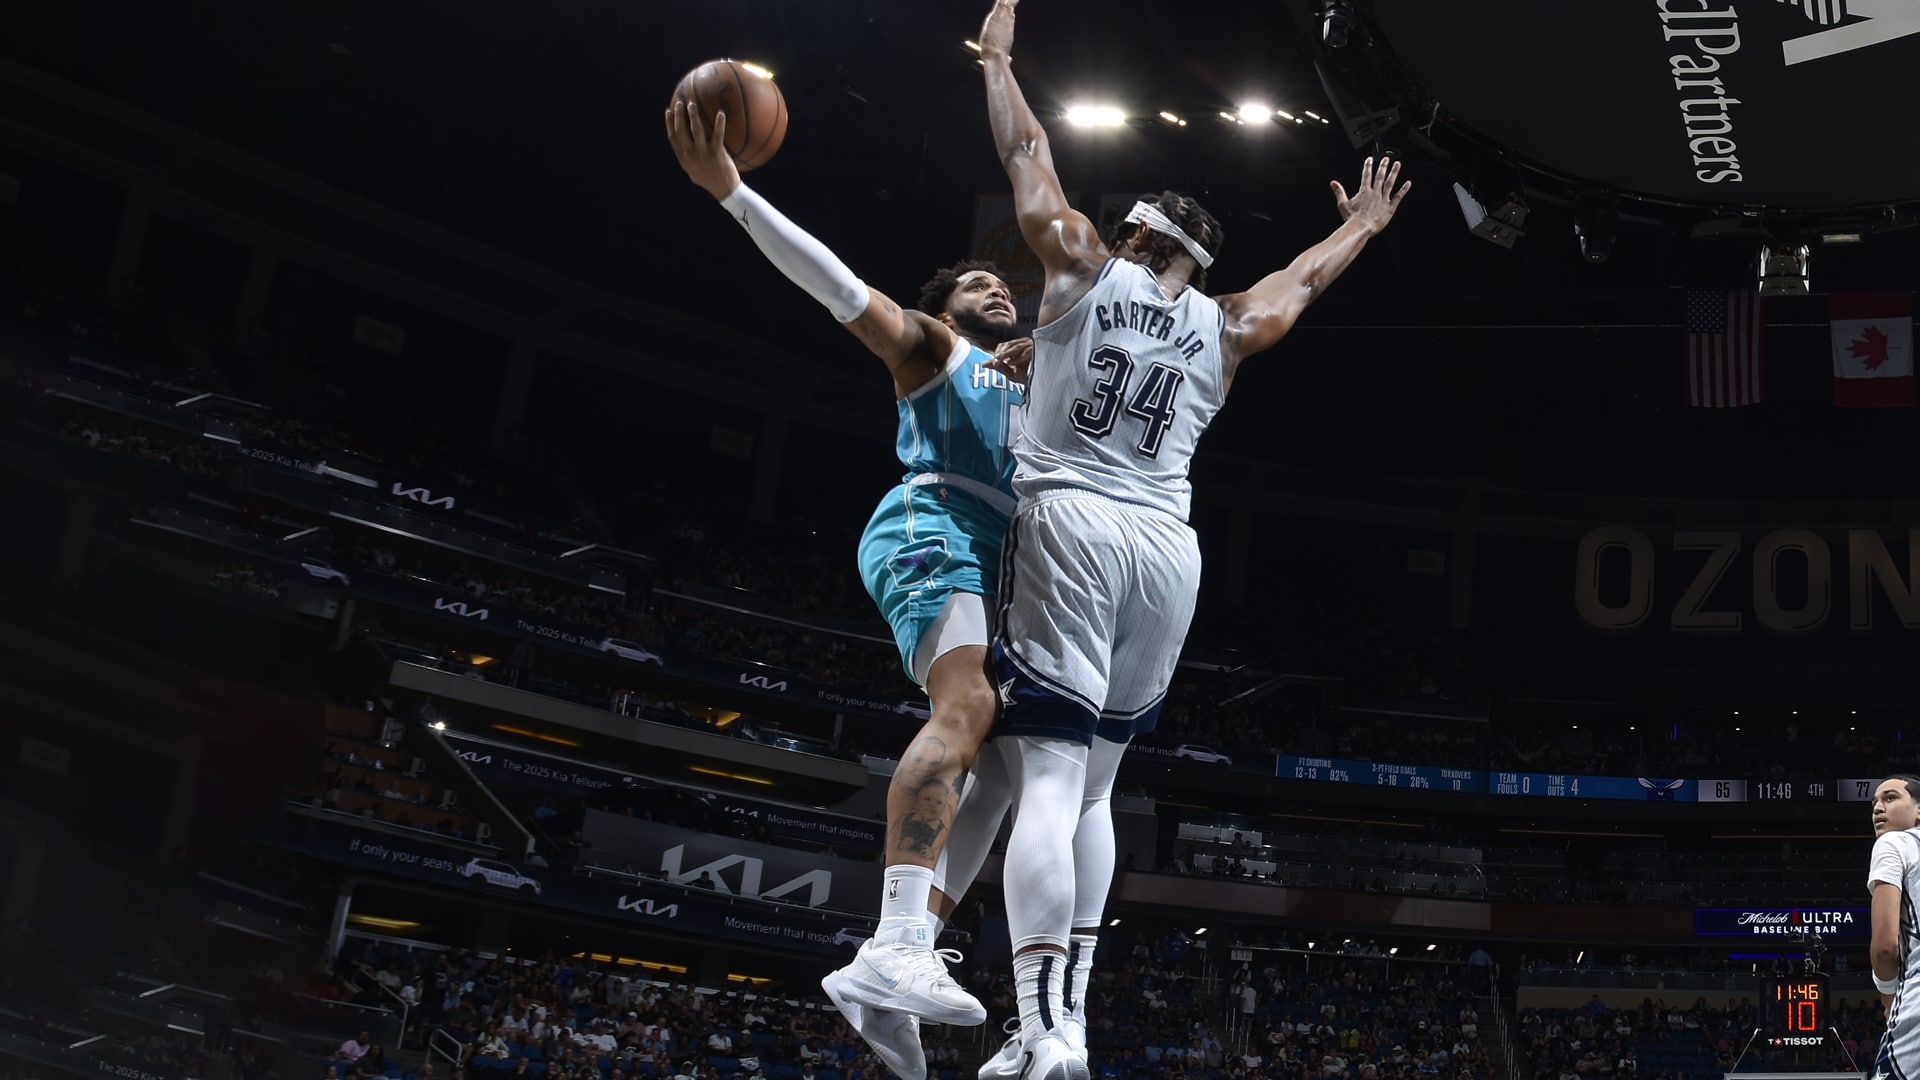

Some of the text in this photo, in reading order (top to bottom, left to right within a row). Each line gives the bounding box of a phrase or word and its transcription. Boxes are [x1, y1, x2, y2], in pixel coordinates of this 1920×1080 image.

[1095, 301, 1204, 365] CARTER JR.
[1070, 344, 1184, 460] 34
[251, 448, 275, 462] 2025
[277, 455, 292, 467] Kia
[391, 482, 455, 510] KIA
[434, 597, 489, 621] KIA
[517, 619, 535, 634] The
[536, 625, 560, 640] 2025
[561, 632, 577, 645] Kia
[739, 672, 788, 692] KIA
[818, 690, 825, 698] If
[826, 692, 844, 705] only
[846, 696, 867, 708] your
[868, 700, 891, 711] seats
[1139, 745, 1156, 755] that
[503, 758, 522, 772] The
[523, 764, 550, 779] 2025
[552, 770, 569, 784] Kia
[1295, 766, 1349, 783] 12-13 92%
[1385, 764, 1400, 775] FIELD
[1499, 773, 1518, 784] TEAM
[1410, 776, 1430, 789] 28%
[1452, 779, 1461, 791] 10
[1497, 783, 1519, 795] FOULS
[1522, 776, 1530, 794] 0
[1548, 775, 1565, 786] TIME
[1570, 778, 1579, 796] 4
[1547, 785, 1565, 797] OUTS
[1715, 781, 1731, 799] 65
[1757, 782, 1825, 800] 11:46 4TH
[1856, 782, 1871, 799] 77
[767, 813, 876, 842] Movement that inspires
[350, 839, 361, 852] If
[362, 845, 390, 861] only
[392, 850, 420, 864] your
[422, 856, 454, 872] seats
[617, 895, 679, 919] KIA
[1737, 911, 1854, 925] Michelob ULTRA
[725, 916, 781, 937] Movement
[783, 927, 806, 940] that
[1753, 925, 1838, 935] BASELINE BAR
[1777, 983, 1820, 1001] 11:46
[1787, 1000, 1817, 1032] 10
[1783, 1036, 1824, 1046] TISSOT
[114, 1065, 140, 1079] 2025
